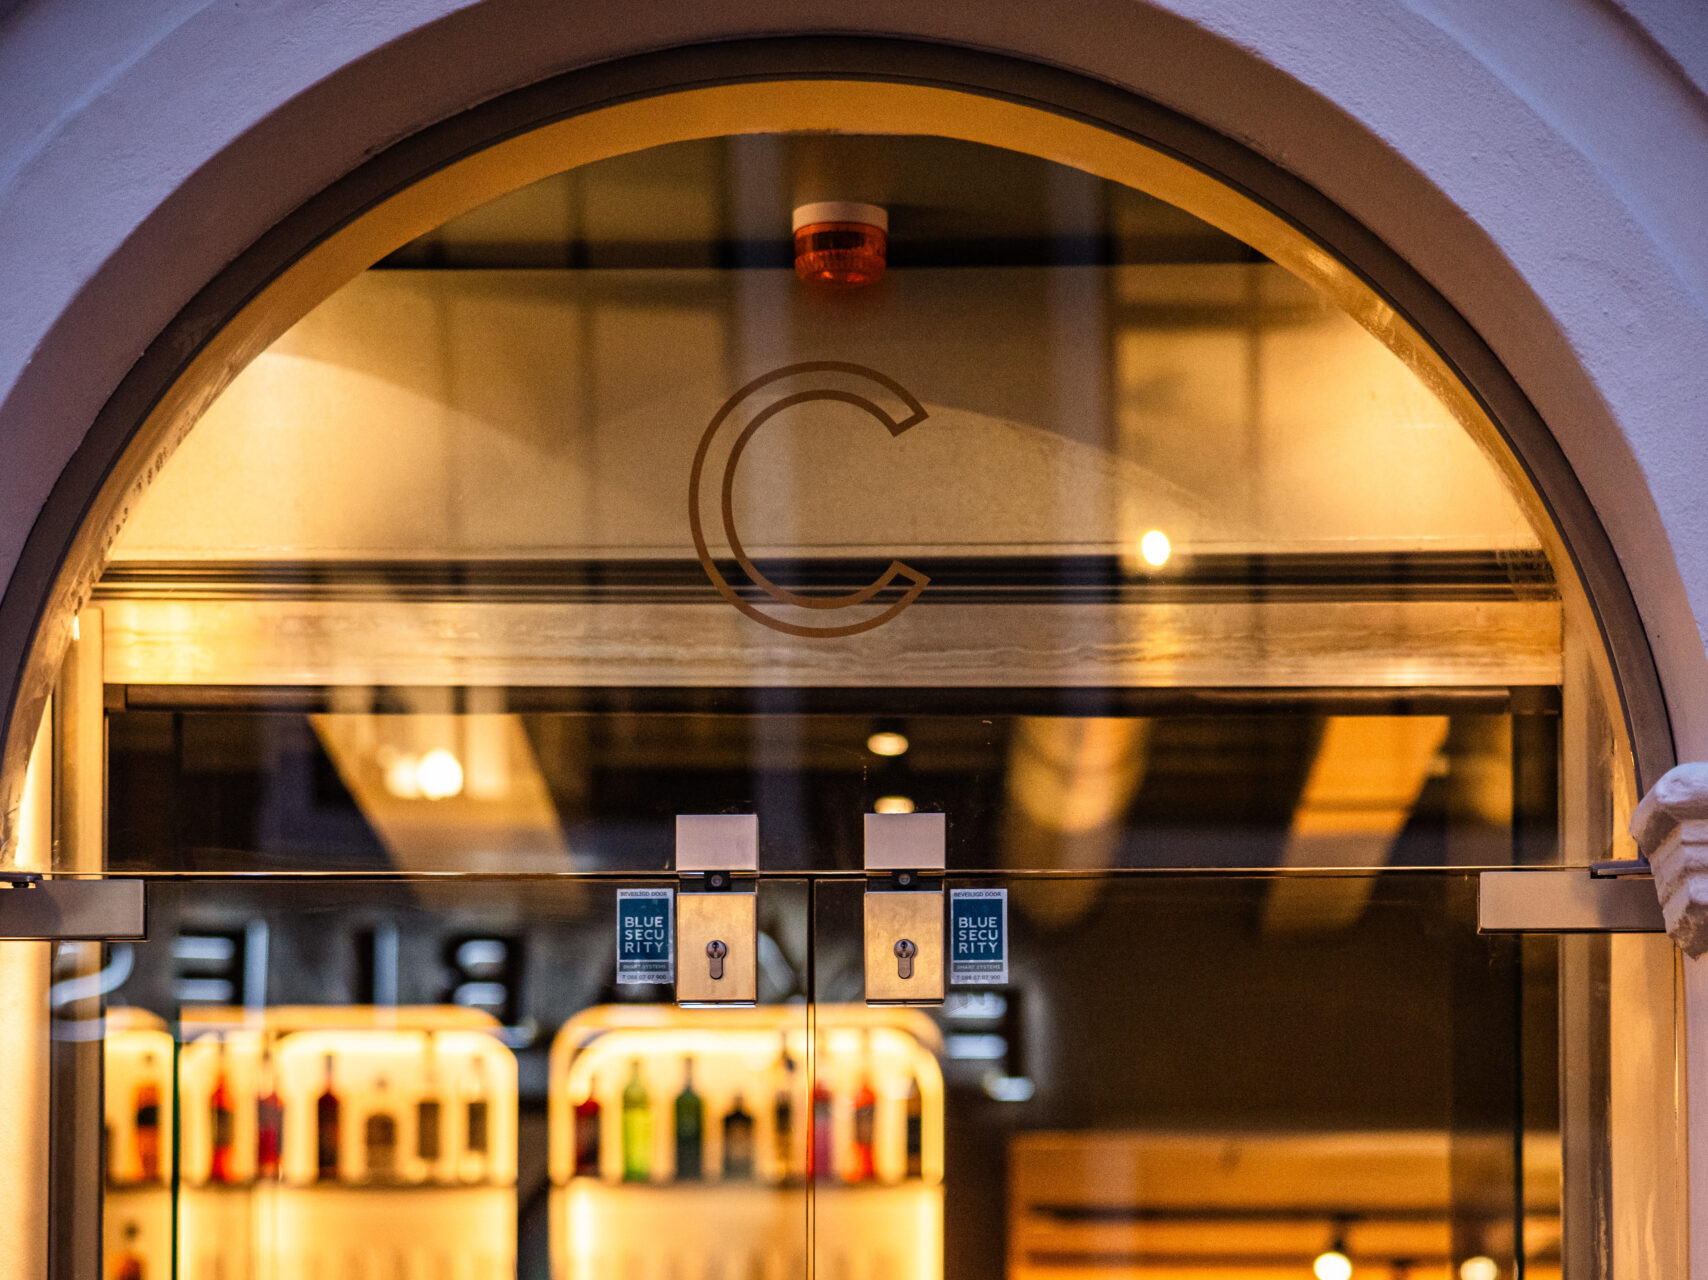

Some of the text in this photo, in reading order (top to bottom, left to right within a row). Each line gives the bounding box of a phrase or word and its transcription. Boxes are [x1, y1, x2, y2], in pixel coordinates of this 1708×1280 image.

[689, 361, 931, 638] C
[624, 916, 664, 928] BLUE
[958, 917, 998, 928] BLUE
[624, 929, 665, 941] SECU
[958, 930, 999, 941] SECU
[624, 942, 664, 953] RITY
[958, 942, 998, 953] RITY
